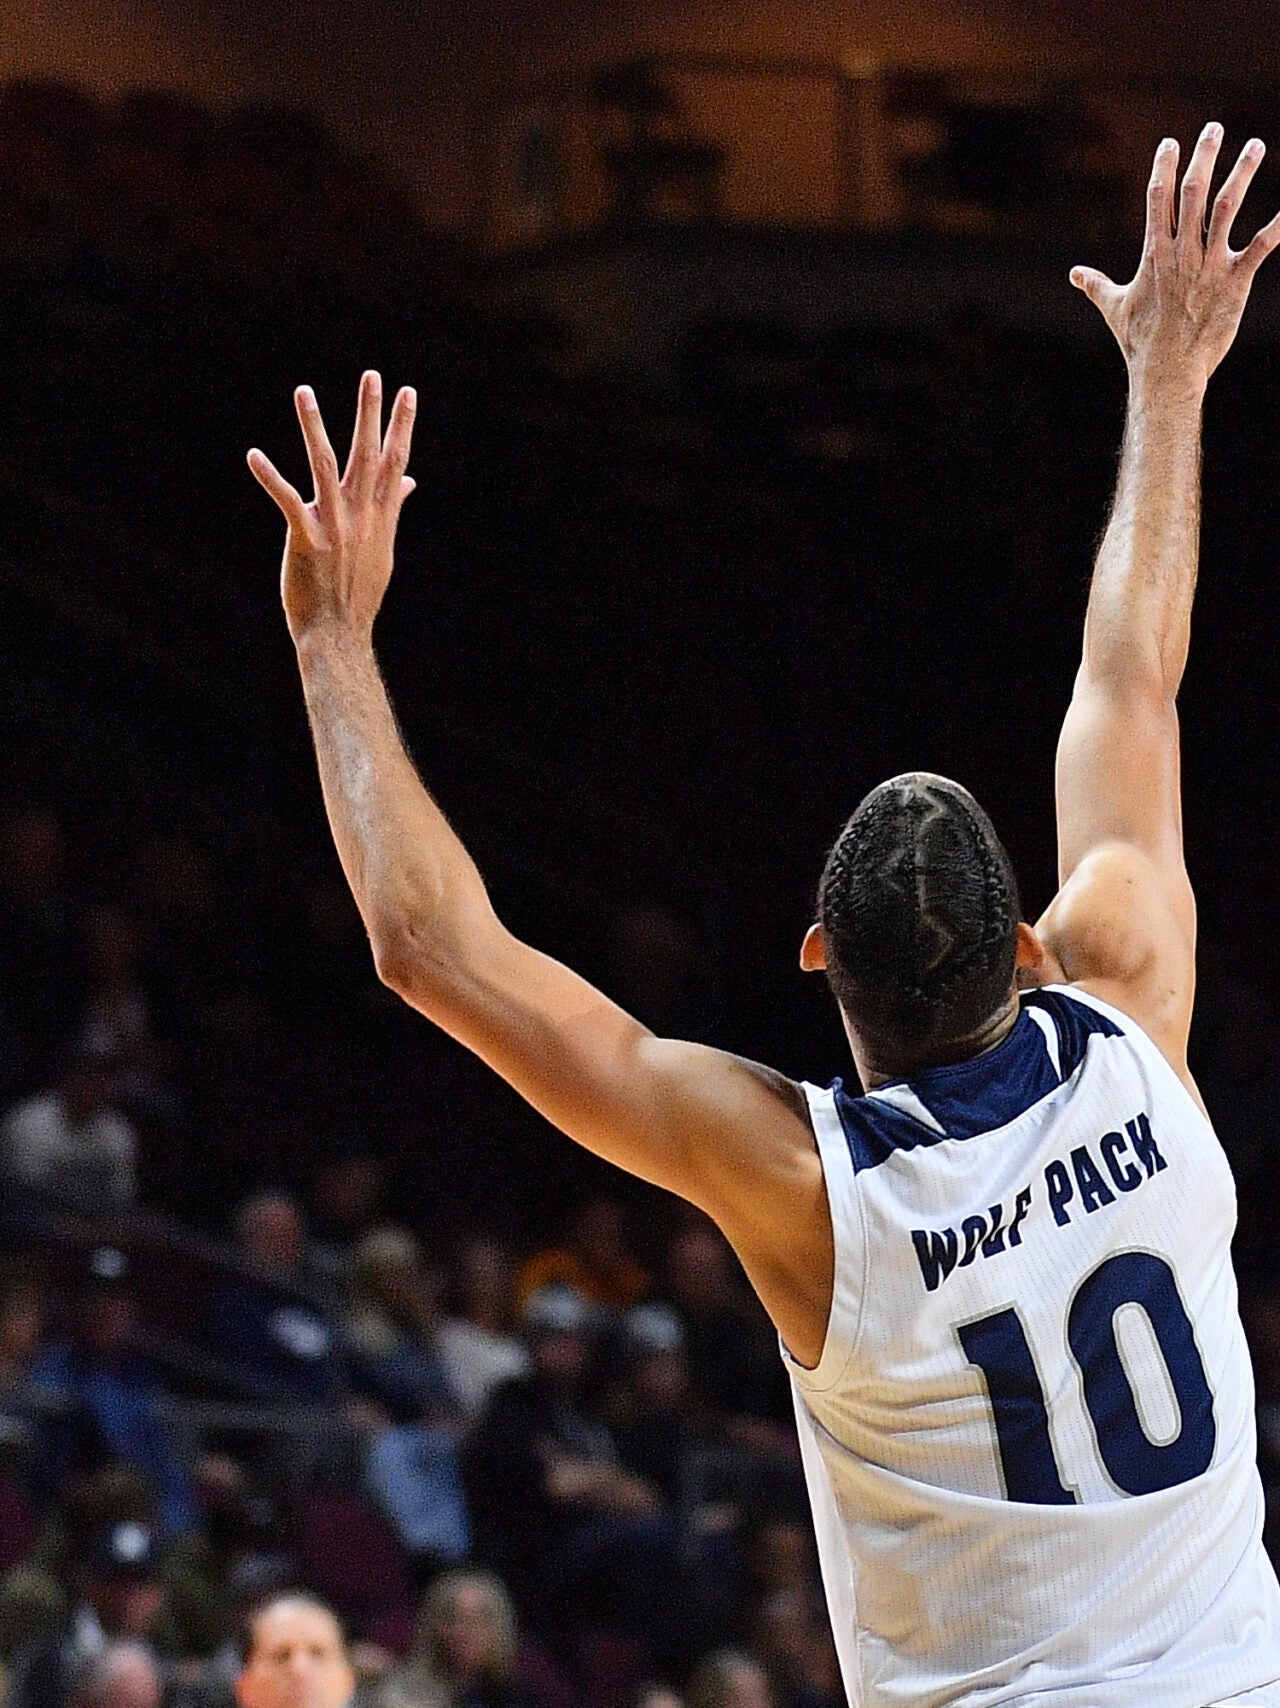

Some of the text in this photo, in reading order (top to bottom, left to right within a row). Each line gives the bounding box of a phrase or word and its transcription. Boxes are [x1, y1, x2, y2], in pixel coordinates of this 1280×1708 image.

[911, 1111, 1168, 1293] WOLF PACK
[952, 1246, 1218, 1506] 10
